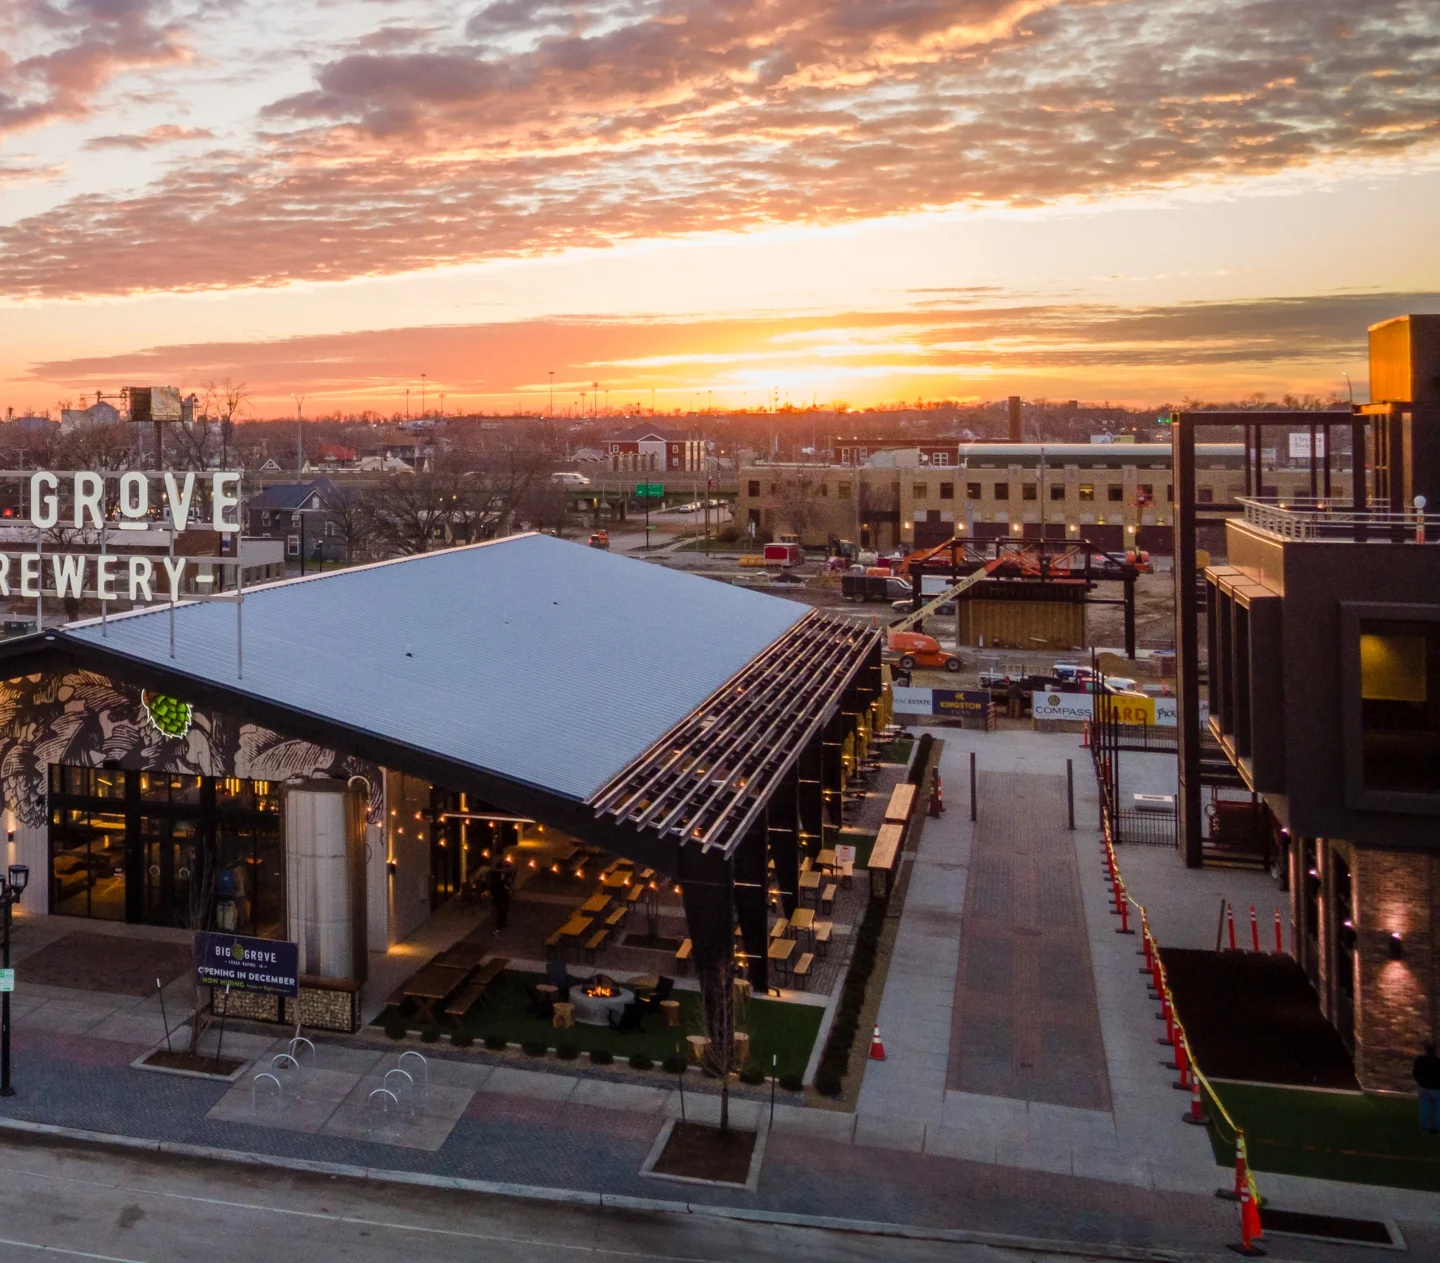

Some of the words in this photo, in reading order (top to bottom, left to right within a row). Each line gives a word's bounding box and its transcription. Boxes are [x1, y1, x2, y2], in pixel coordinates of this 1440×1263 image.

[31, 471, 241, 532] GROVE
[940, 701, 982, 710] KINGSTON
[1035, 706, 1092, 717] COMPASS
[215, 946, 231, 957] BIG
[244, 950, 277, 963] GROVE
[198, 966, 235, 978] OPENING
[237, 971, 246, 979] IN
[248, 973, 295, 986] DECEMBER
[220, 979, 245, 988] HIRING
